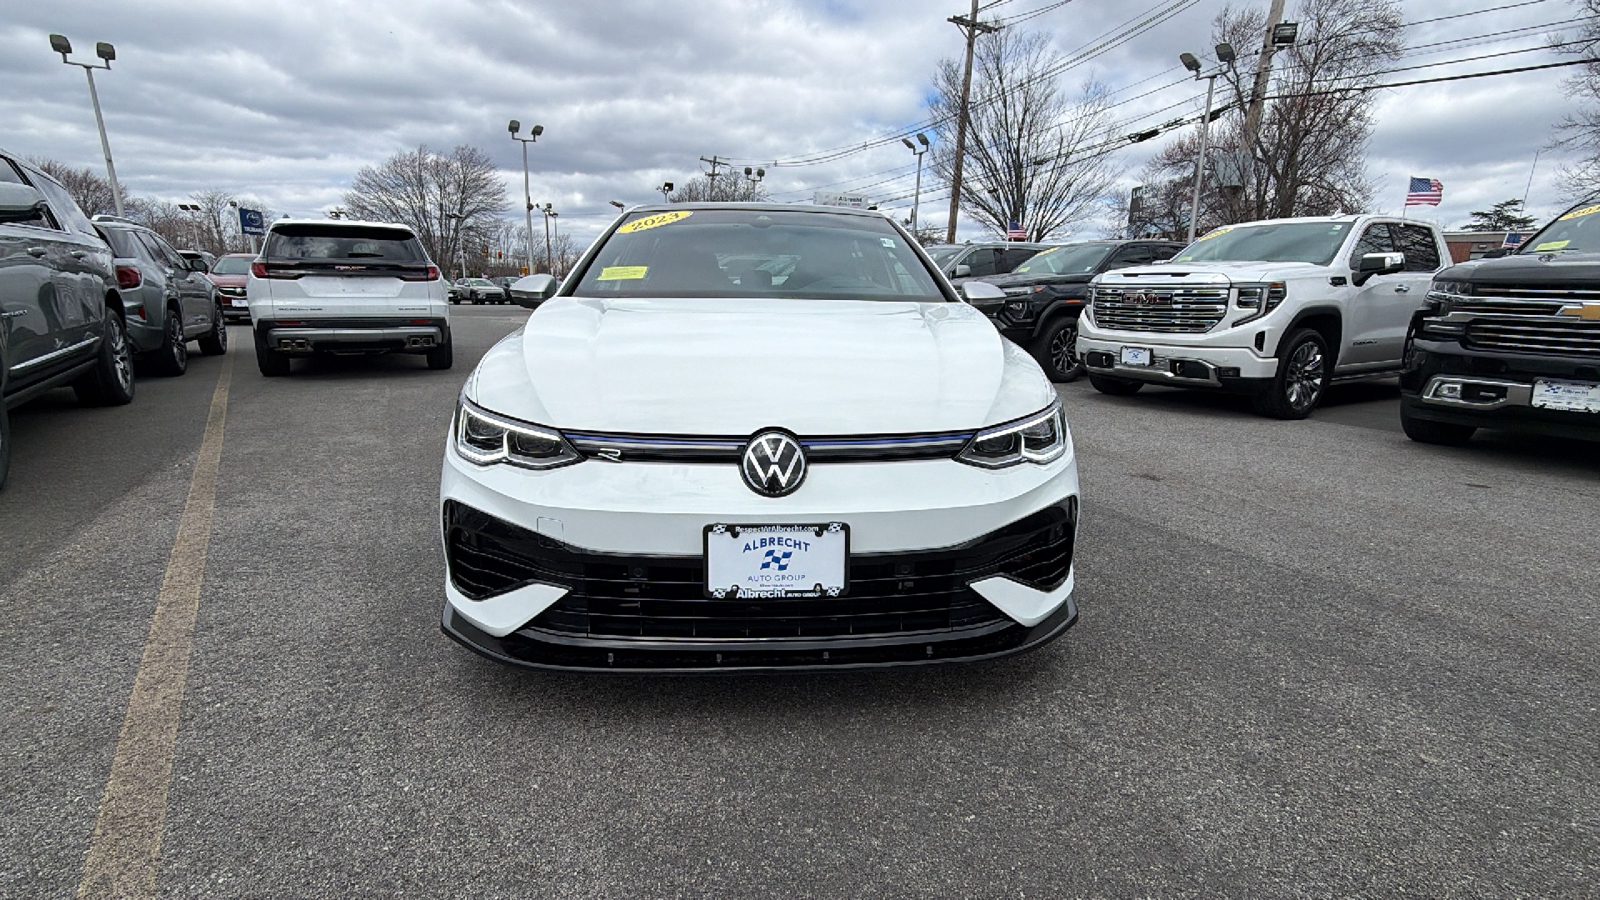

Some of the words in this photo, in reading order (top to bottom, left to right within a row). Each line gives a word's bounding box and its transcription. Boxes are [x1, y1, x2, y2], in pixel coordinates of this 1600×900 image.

[631, 213, 680, 231] 2023
[1122, 293, 1172, 304] GMC
[598, 448, 622, 463] R
[742, 536, 811, 553] ALBRECHT
[747, 574, 772, 582] AUTO
[774, 574, 806, 582] GROUP
[735, 588, 786, 599] Albrecht
